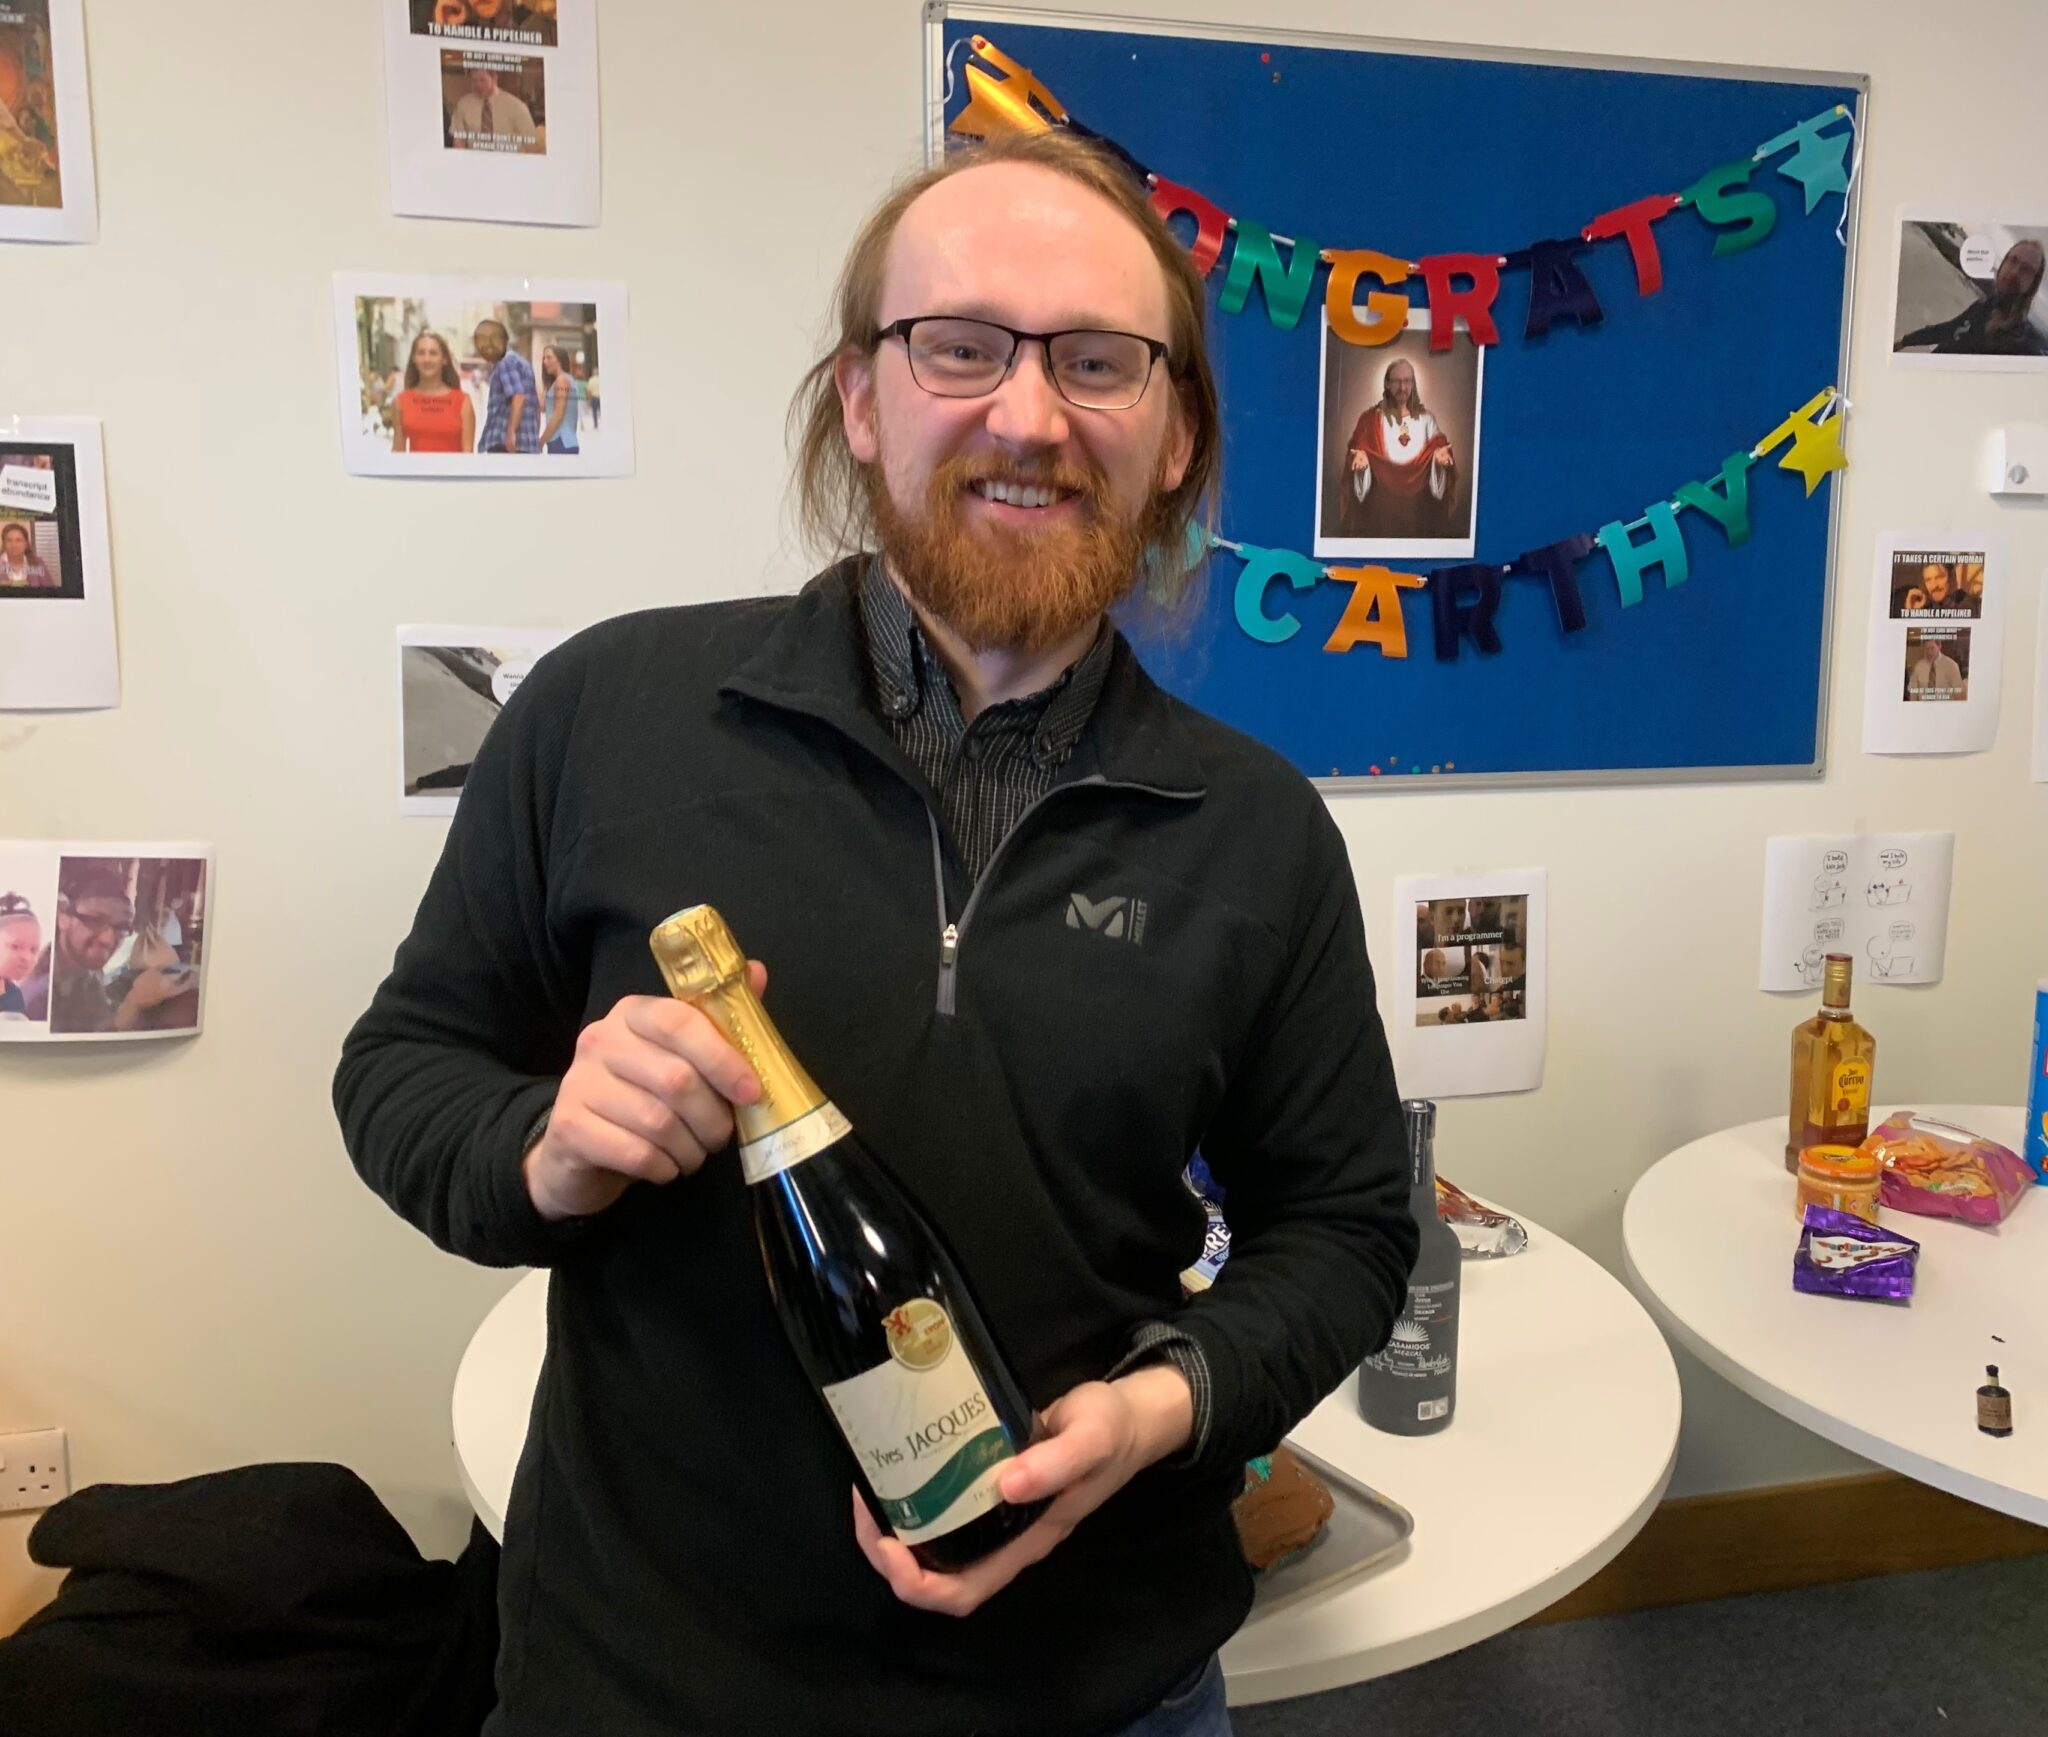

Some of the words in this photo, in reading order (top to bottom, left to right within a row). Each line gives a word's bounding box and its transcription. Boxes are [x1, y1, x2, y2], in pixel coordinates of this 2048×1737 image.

[428, 22, 441, 35] TO
[443, 23, 482, 39] HANDLE
[484, 26, 491, 39] A
[493, 28, 543, 44] PIPELINER
[1064, 118, 1777, 351] ONGRATS
[6, 477, 48, 491] transcript
[1, 486, 51, 501] abundance
[1894, 554, 1901, 563] IT
[1902, 554, 1923, 563] TAKES
[1923, 554, 1928, 563] A
[1929, 554, 1956, 564] CERTAIN
[1957, 555, 1984, 564] WOMAN
[1910, 608, 1935, 618] HANDLE
[1437, 934, 1449, 942] I'm
[1456, 931, 1503, 943] programmer
[869, 1448, 904, 1468] Yves
[906, 1392, 986, 1460] JACQUES
